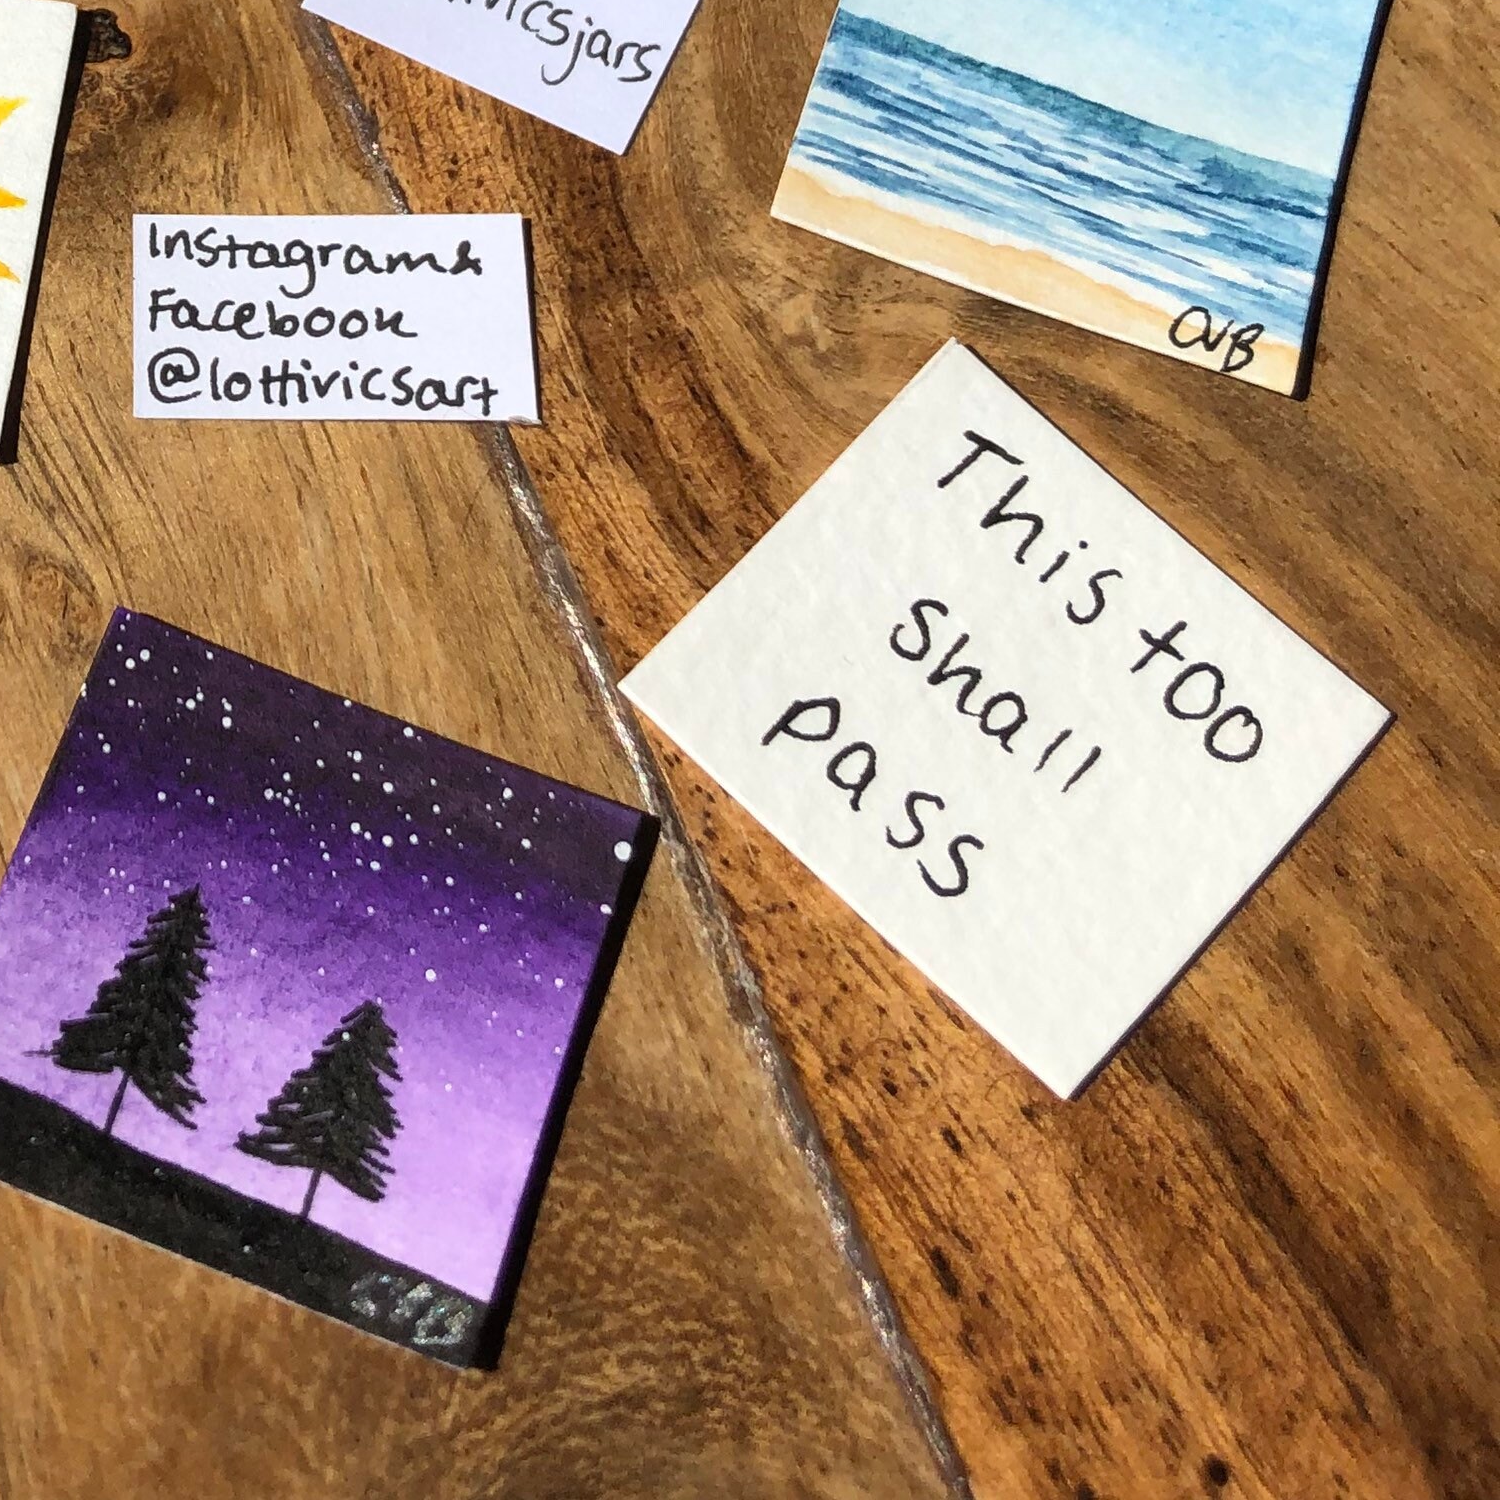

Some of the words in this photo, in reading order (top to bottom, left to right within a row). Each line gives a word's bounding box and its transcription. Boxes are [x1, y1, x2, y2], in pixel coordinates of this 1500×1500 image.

[147, 346, 498, 416] @lottivicsart
[149, 288, 418, 340] Facebook
[936, 430, 1122, 625] This
[1130, 620, 1262, 762] too
[761, 696, 984, 898] pass
